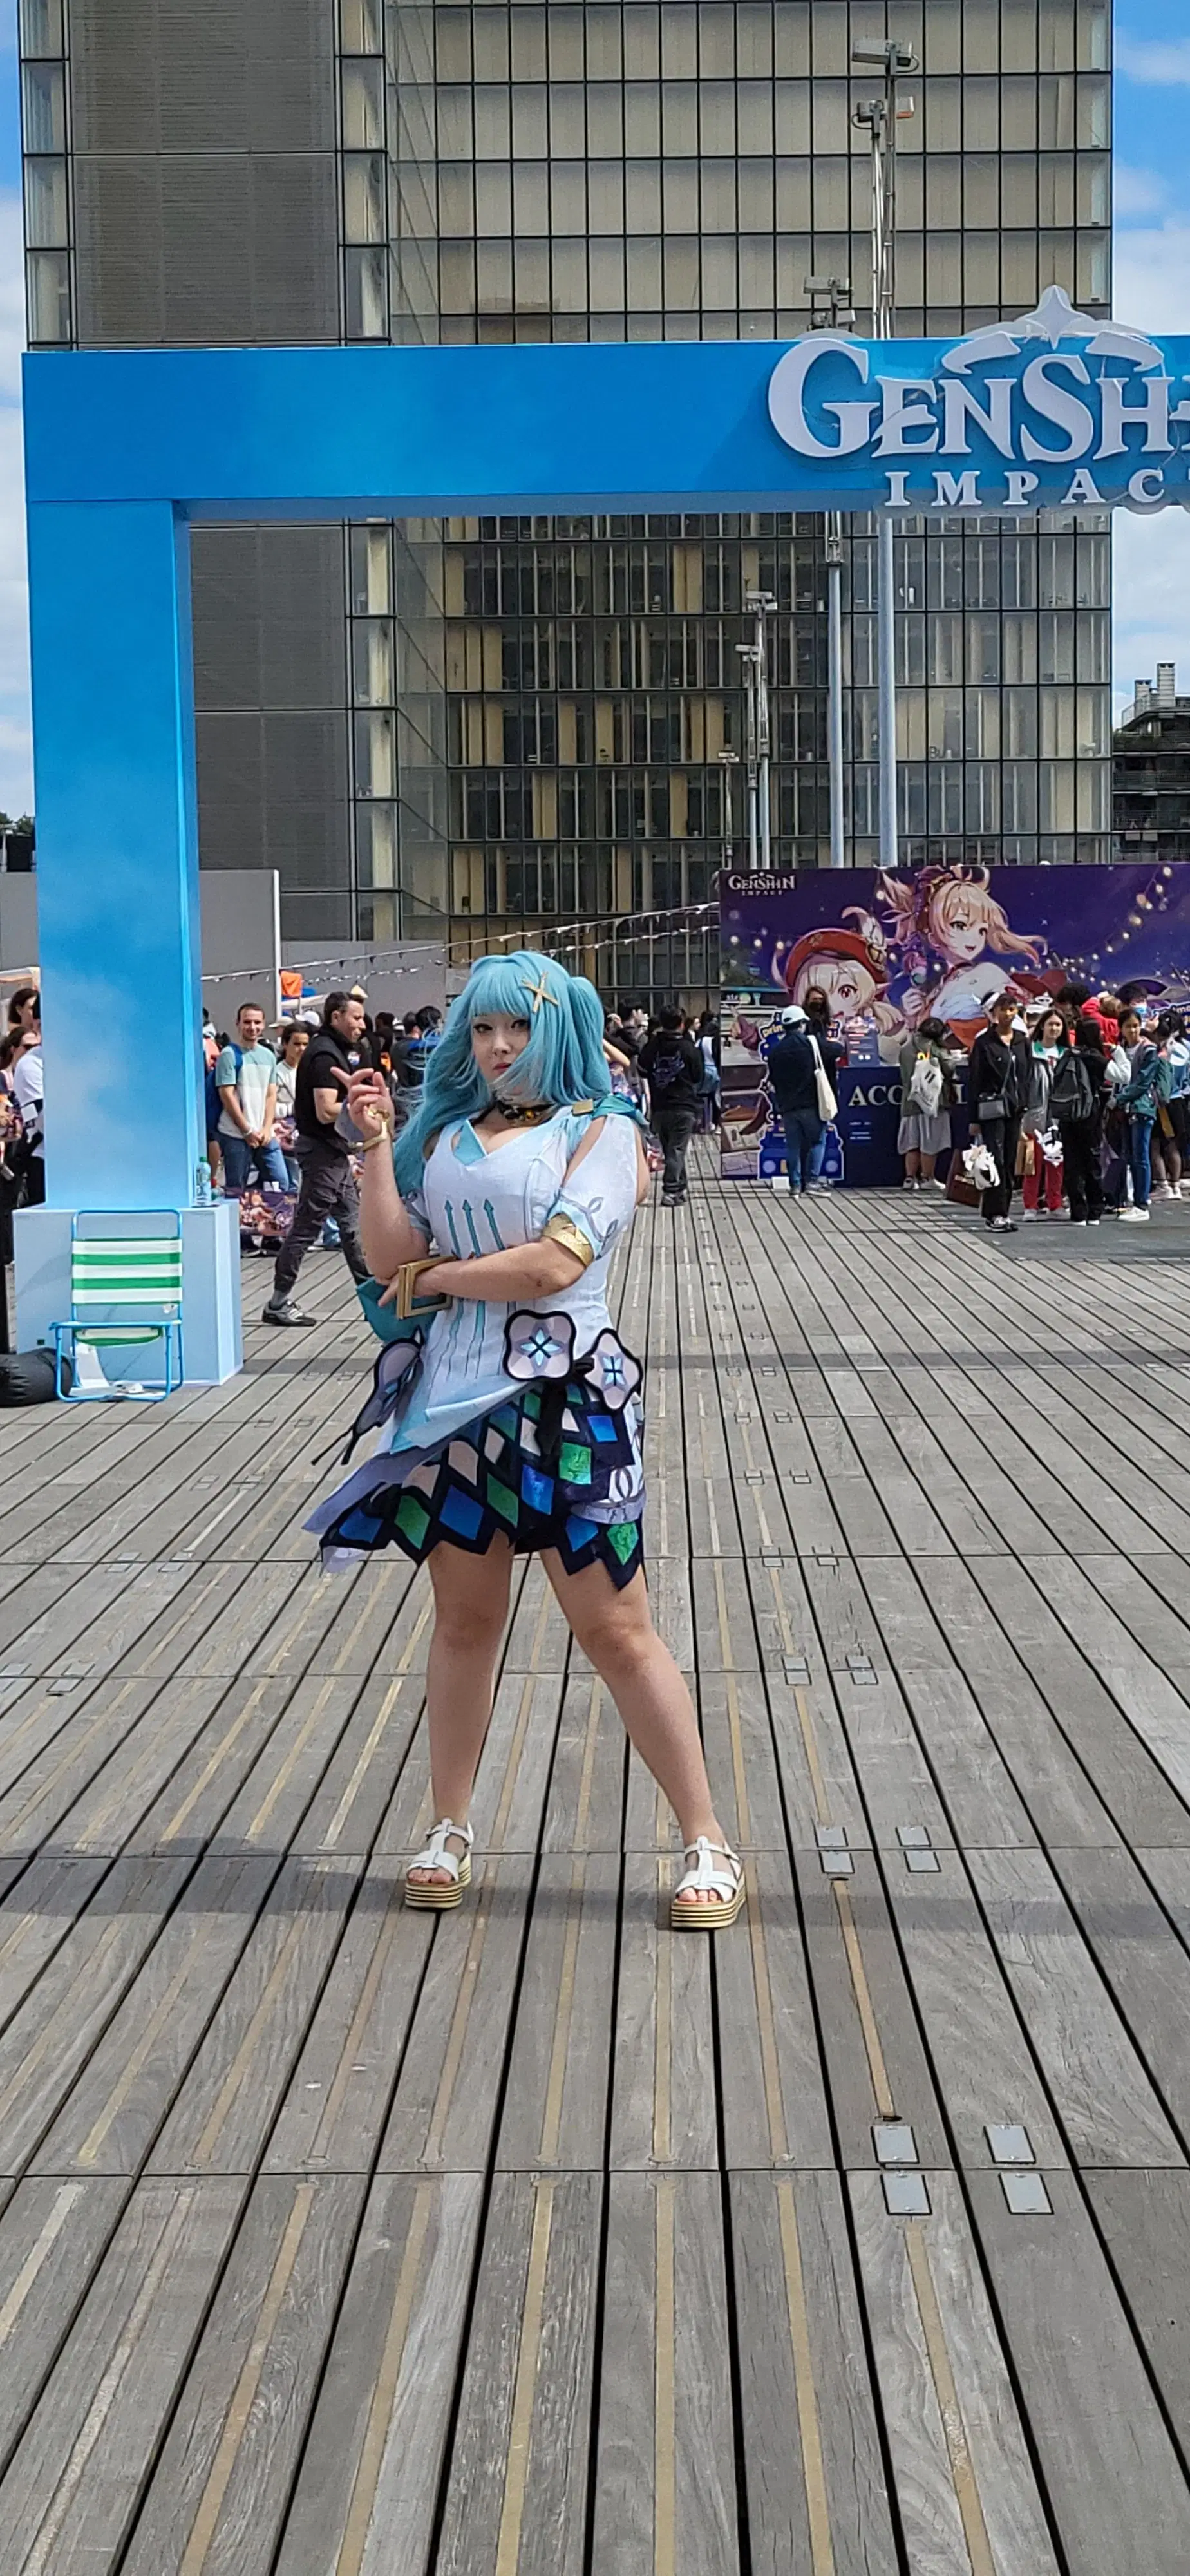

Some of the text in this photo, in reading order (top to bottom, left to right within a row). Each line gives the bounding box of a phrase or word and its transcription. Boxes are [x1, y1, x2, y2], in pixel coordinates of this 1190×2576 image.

[768, 338, 1190, 462] GENSH
[884, 468, 1190, 507] IMPAC
[728, 875, 795, 890] GENSHIN
